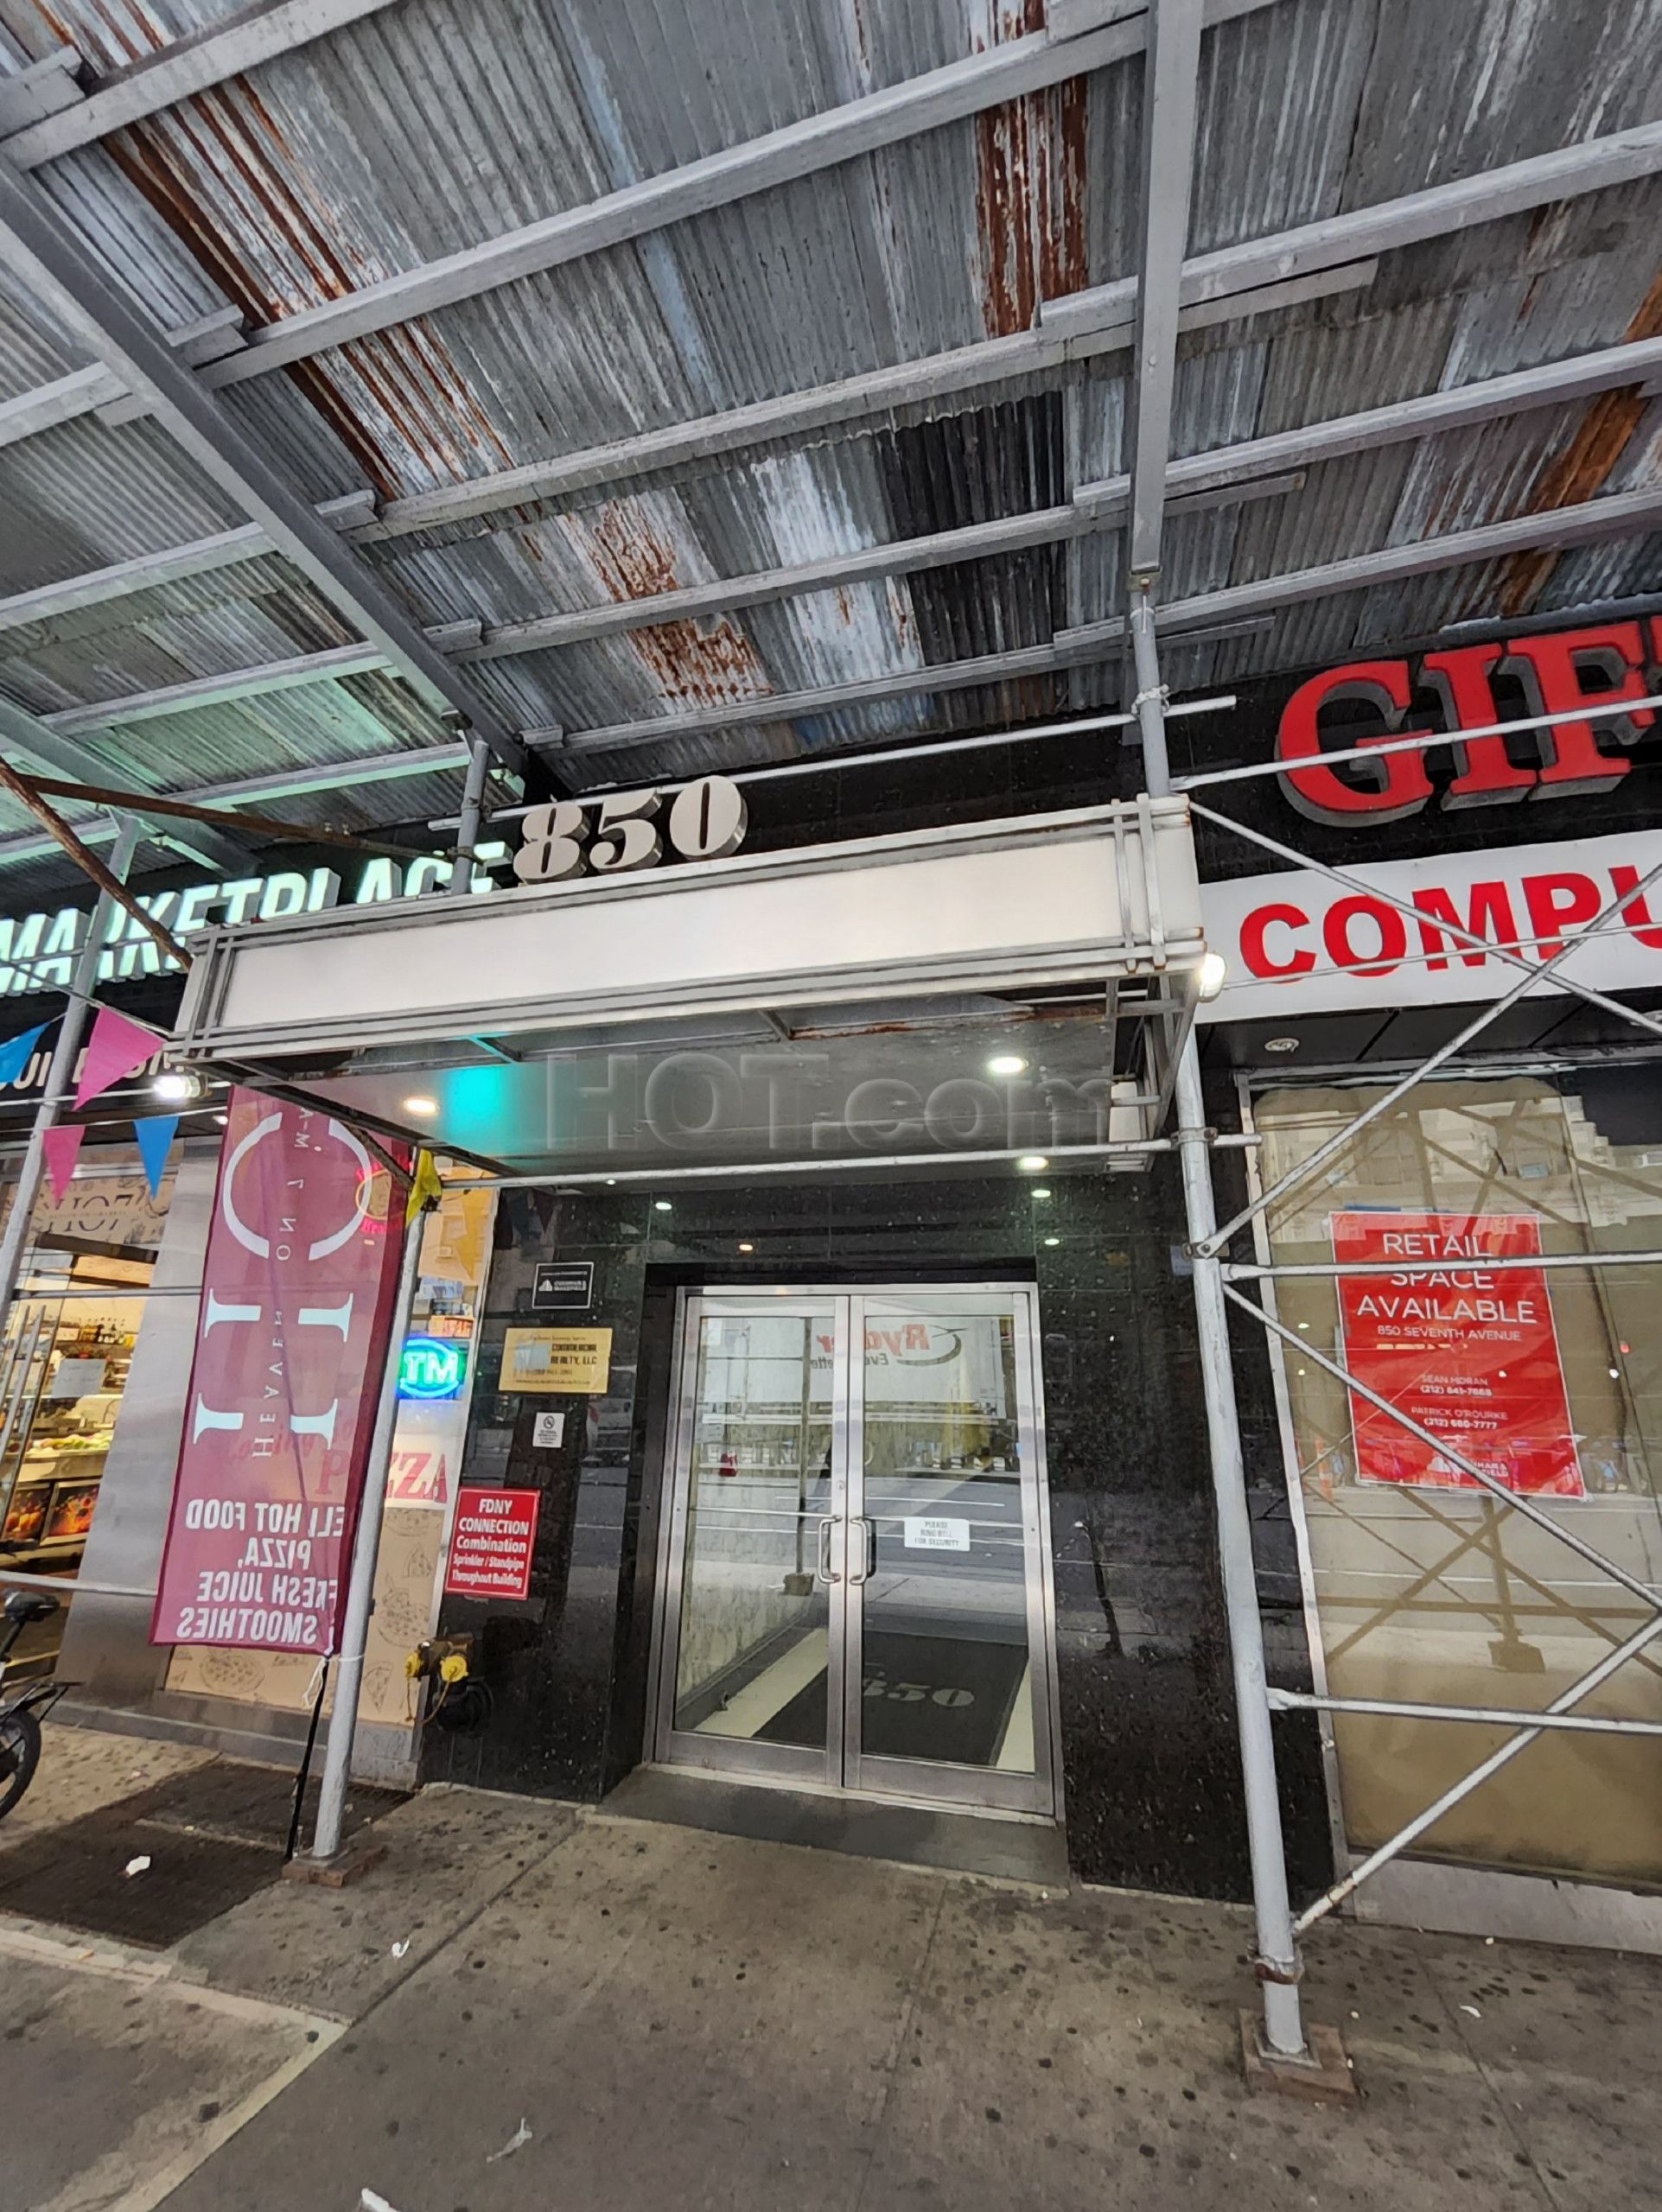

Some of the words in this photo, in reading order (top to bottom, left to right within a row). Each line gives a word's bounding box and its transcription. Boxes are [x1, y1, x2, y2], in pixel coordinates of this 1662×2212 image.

[1275, 616, 1662, 827] GIF
[513, 775, 748, 885] 850
[1383, 1233, 1493, 1258] RETAIL
[1391, 1271, 1495, 1290] SPACE
[1357, 1294, 1538, 1325] AVAILABLE
[1377, 1325, 1401, 1336] 850
[1404, 1326, 1464, 1338] SEVENTH
[1468, 1330, 1522, 1341] AVENUE
[402, 1350, 459, 1384] TM
[1410, 1407, 1453, 1416] PATRICK
[479, 1497, 513, 1515] FDNY
[459, 1516, 530, 1535] CONNECTION
[456, 1535, 527, 1554] Combination
[453, 1553, 485, 1567] Sprinkler
[492, 1573, 523, 1589] Building
